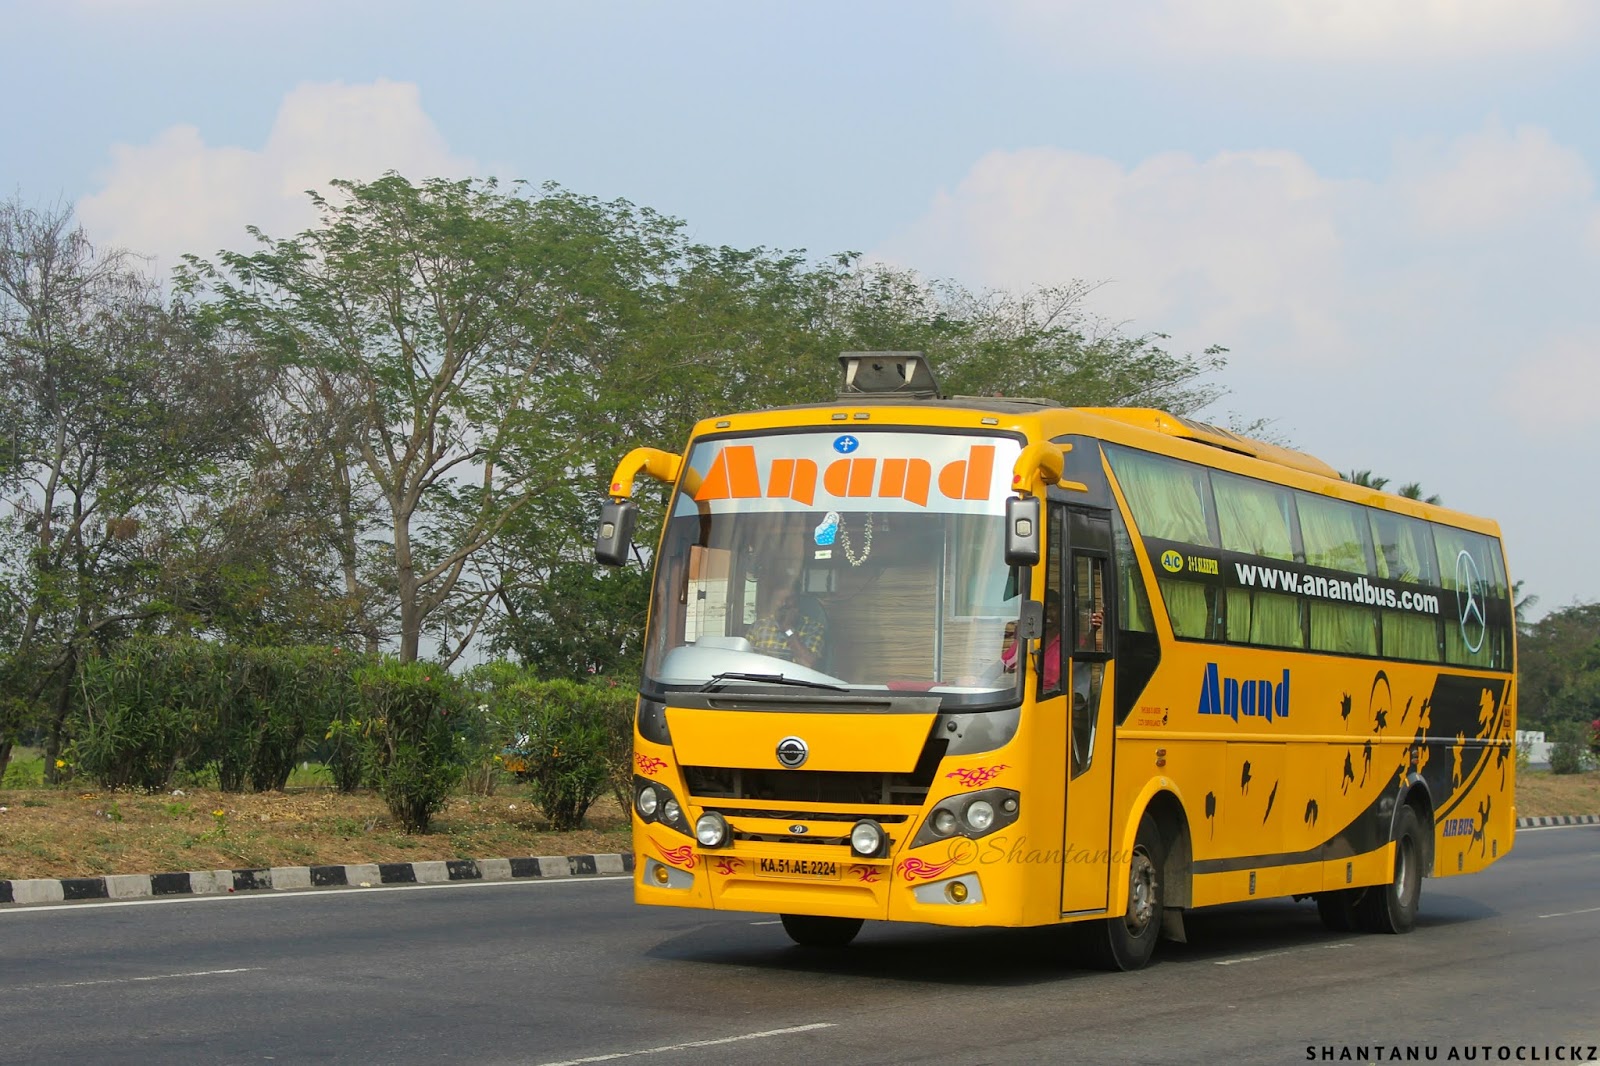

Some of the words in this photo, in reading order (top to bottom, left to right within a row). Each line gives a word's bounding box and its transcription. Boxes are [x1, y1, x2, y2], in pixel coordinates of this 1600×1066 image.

[694, 445, 995, 507] Anand
[1163, 553, 1181, 569] A/C
[1235, 562, 1440, 614] www.anandbus.com
[1197, 662, 1290, 724] Anand
[1442, 819, 1459, 837] AIR
[1457, 818, 1474, 836] BUS
[760, 858, 837, 876] KA.51.AE.2224
